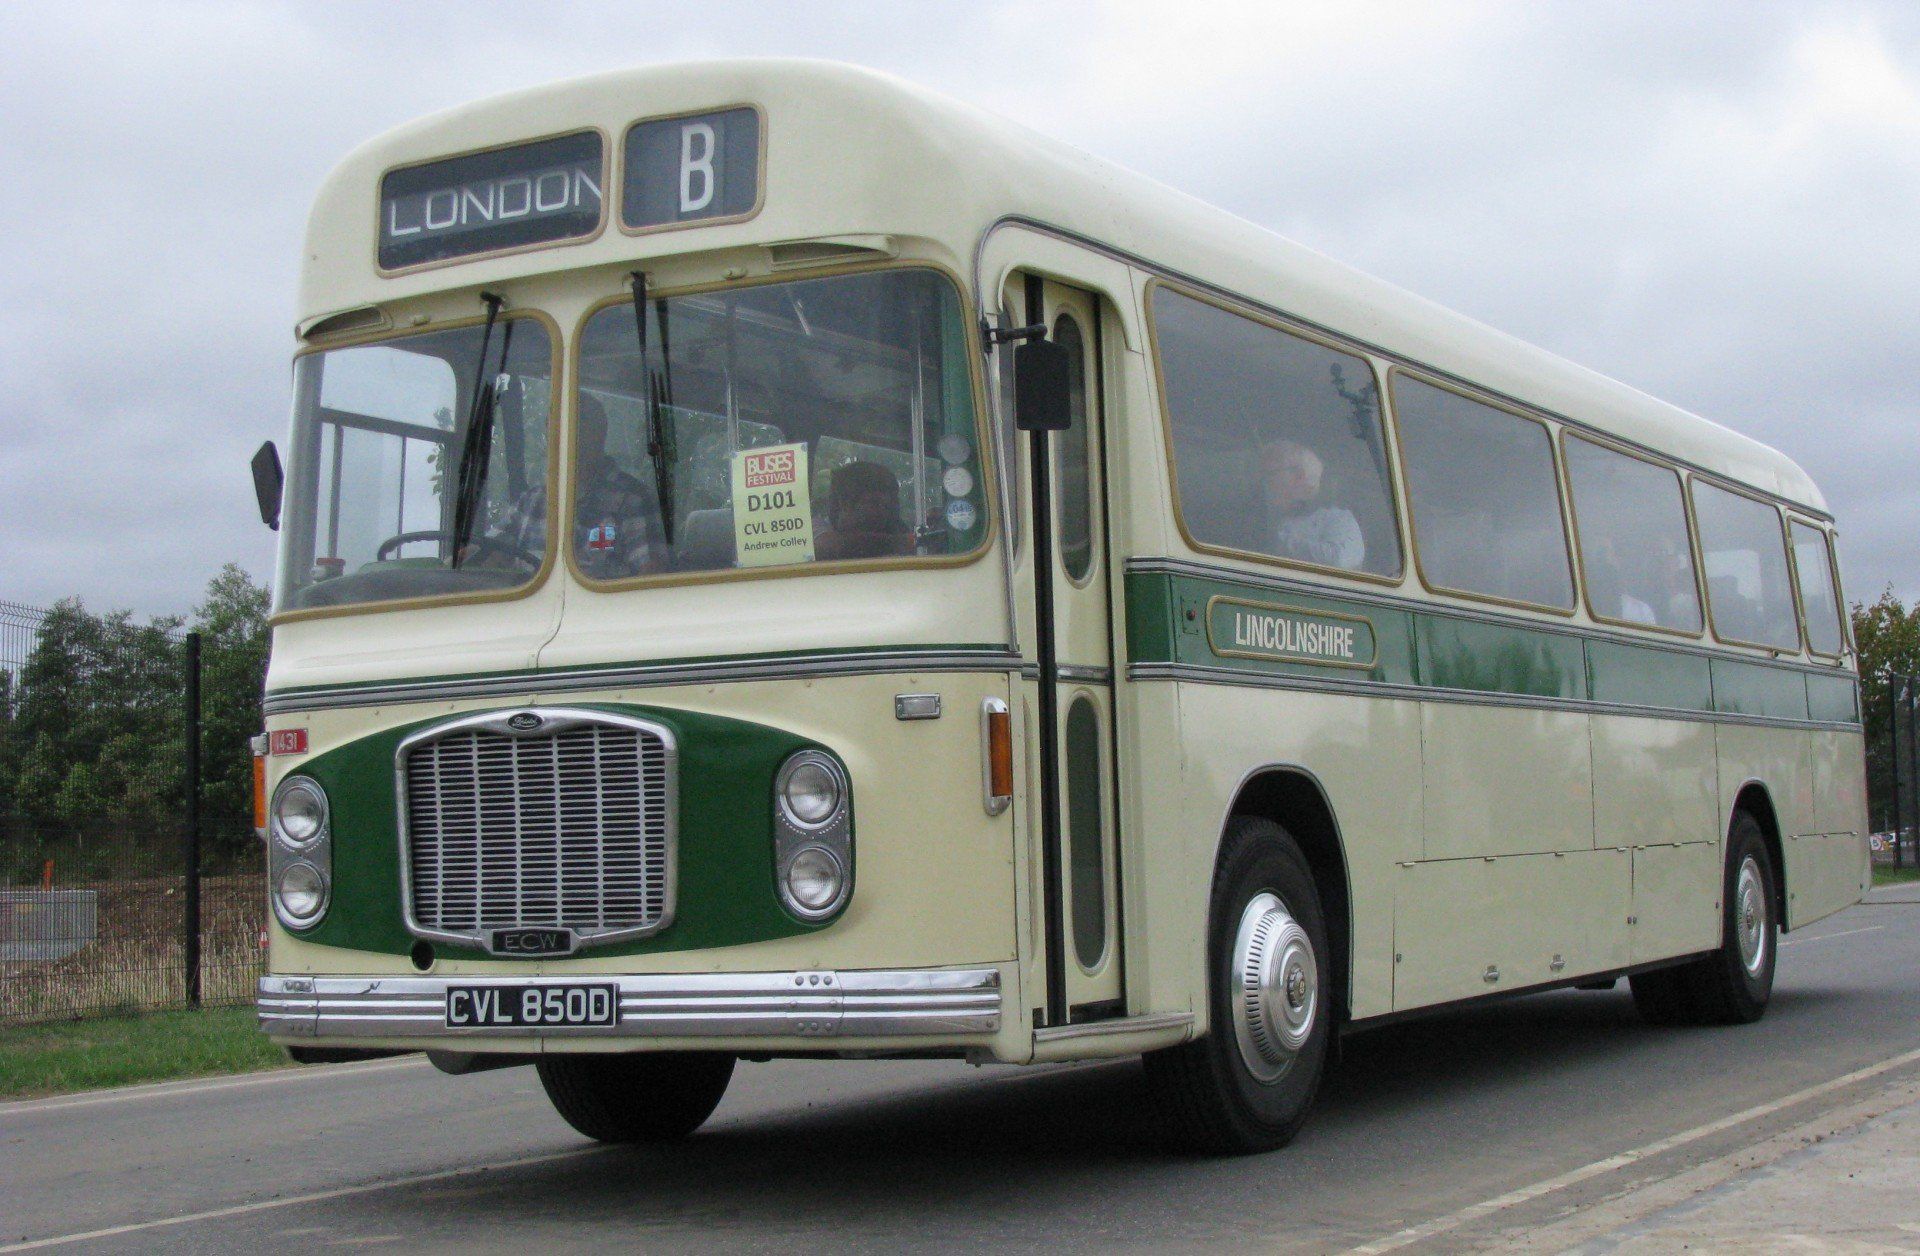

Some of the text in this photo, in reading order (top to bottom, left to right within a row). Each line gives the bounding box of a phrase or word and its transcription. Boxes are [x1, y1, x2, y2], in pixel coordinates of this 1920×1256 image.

[680, 122, 716, 214] B
[390, 168, 602, 237] LONDON
[747, 452, 793, 477] BUSES
[747, 471, 793, 486] FESTIVAL
[748, 490, 796, 512] D101
[744, 518, 804, 535] CVL 850D
[744, 537, 807, 552] Andrew Colley
[1235, 612, 1354, 659] LINCOLNSHIRE
[505, 932, 559, 950] ECW
[450, 988, 610, 1024] CVL 850D
